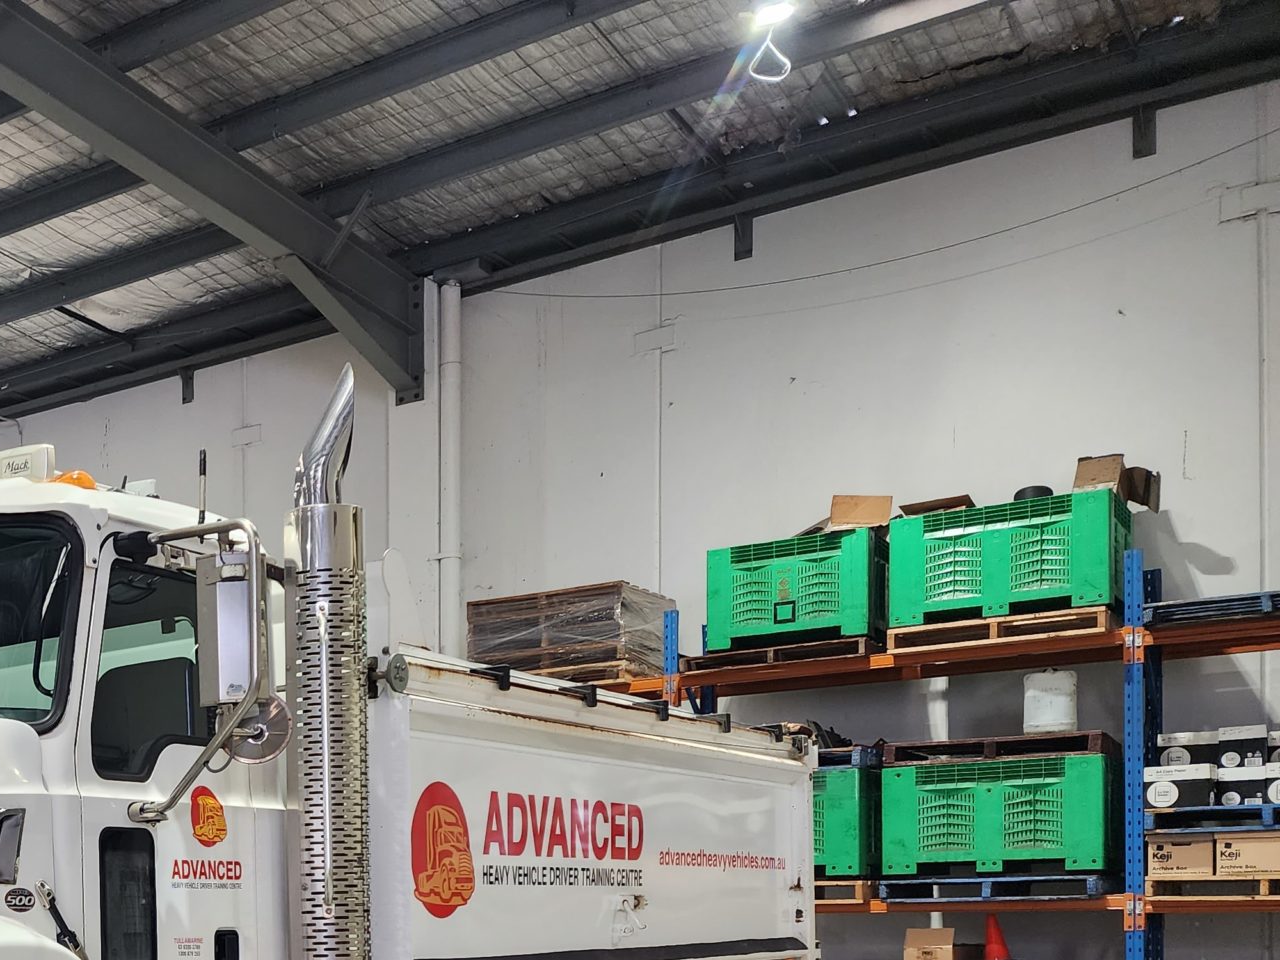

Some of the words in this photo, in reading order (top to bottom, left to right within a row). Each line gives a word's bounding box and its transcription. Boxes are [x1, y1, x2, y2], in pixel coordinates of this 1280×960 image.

[4, 459, 30, 474] Mack
[483, 790, 644, 861] ADVANCED
[659, 847, 786, 872] advancedheavyvehicles.com.au
[1152, 851, 1172, 862] Keji
[1220, 849, 1241, 861] Keji
[172, 859, 242, 880] ADVANCED
[482, 865, 510, 885] HEAVY
[512, 866, 547, 885] VEHICLE
[549, 867, 579, 886] DRIVER
[581, 868, 615, 887] TRAINING
[616, 869, 643, 887] CENTRE
[6, 896, 35, 906] 500
